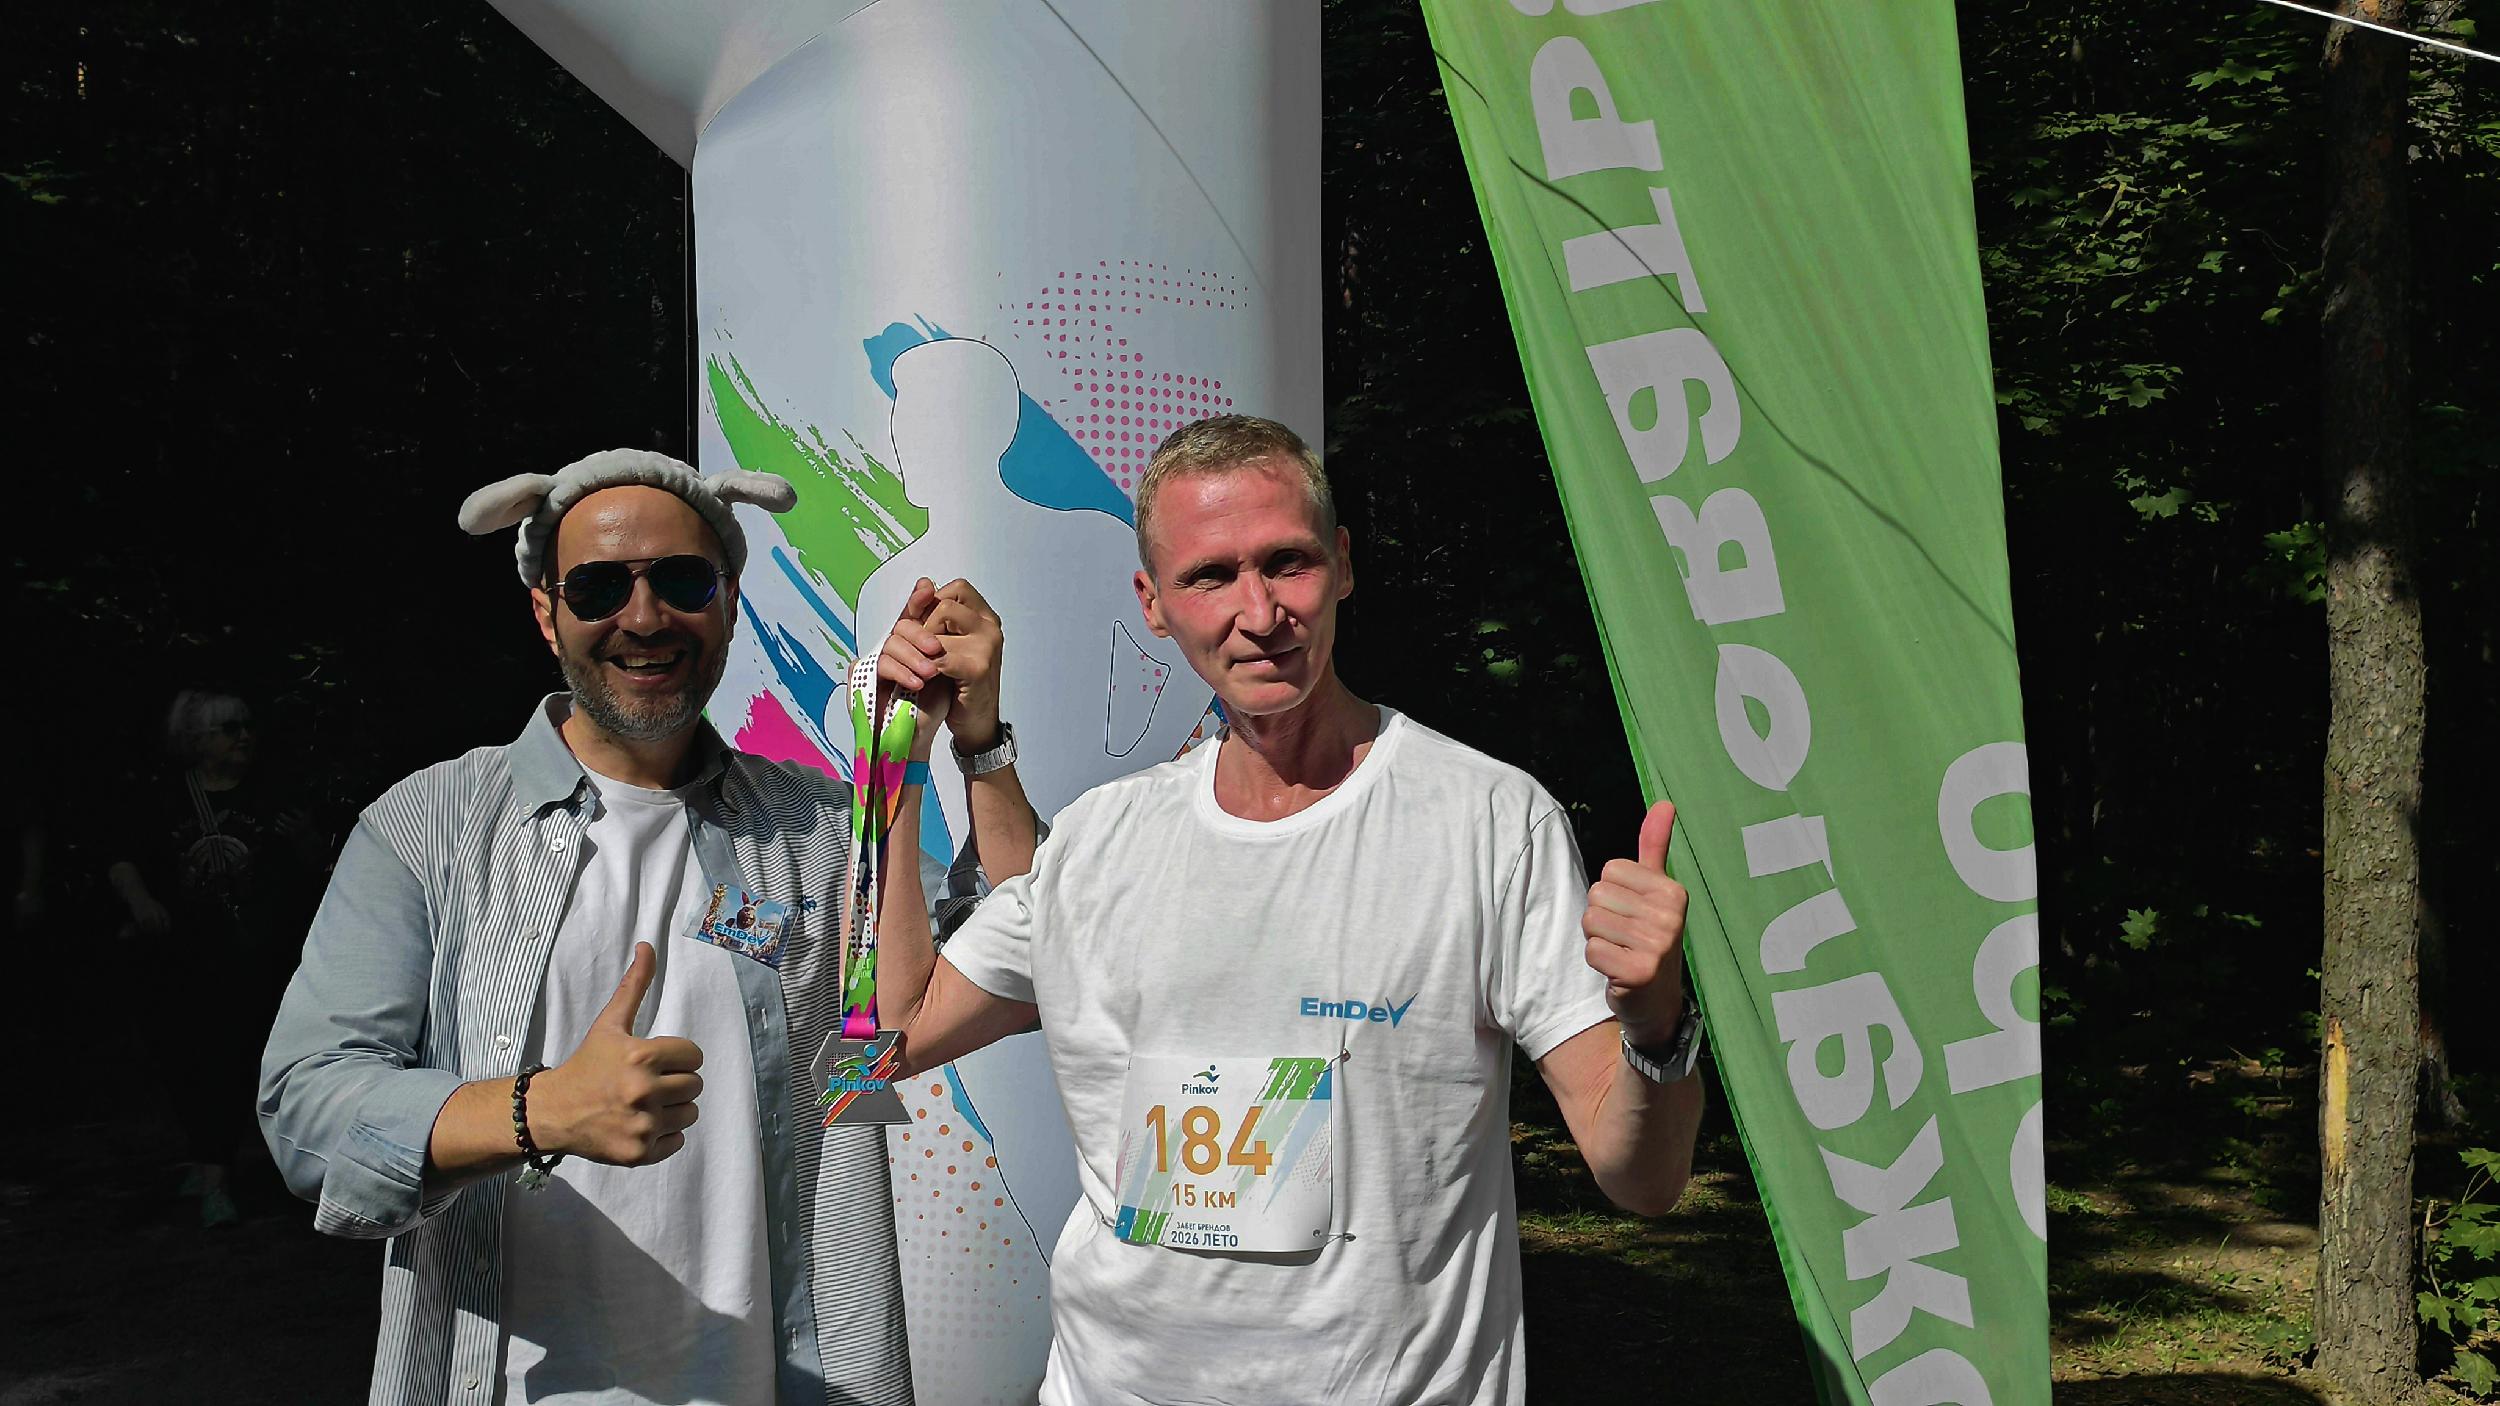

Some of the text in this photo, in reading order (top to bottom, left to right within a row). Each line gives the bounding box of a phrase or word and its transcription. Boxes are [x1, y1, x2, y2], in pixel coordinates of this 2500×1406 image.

[828, 1076, 886, 1092] Pinkov
[1181, 1084, 1219, 1095] Pinkov
[1146, 1105, 1273, 1176] 184
[1172, 1184, 1196, 1207] 15
[1176, 1221, 1231, 1232] ЗАБЕГ БРЕНДОВ
[1171, 1231, 1239, 1247] 2026 ЛЕТО
